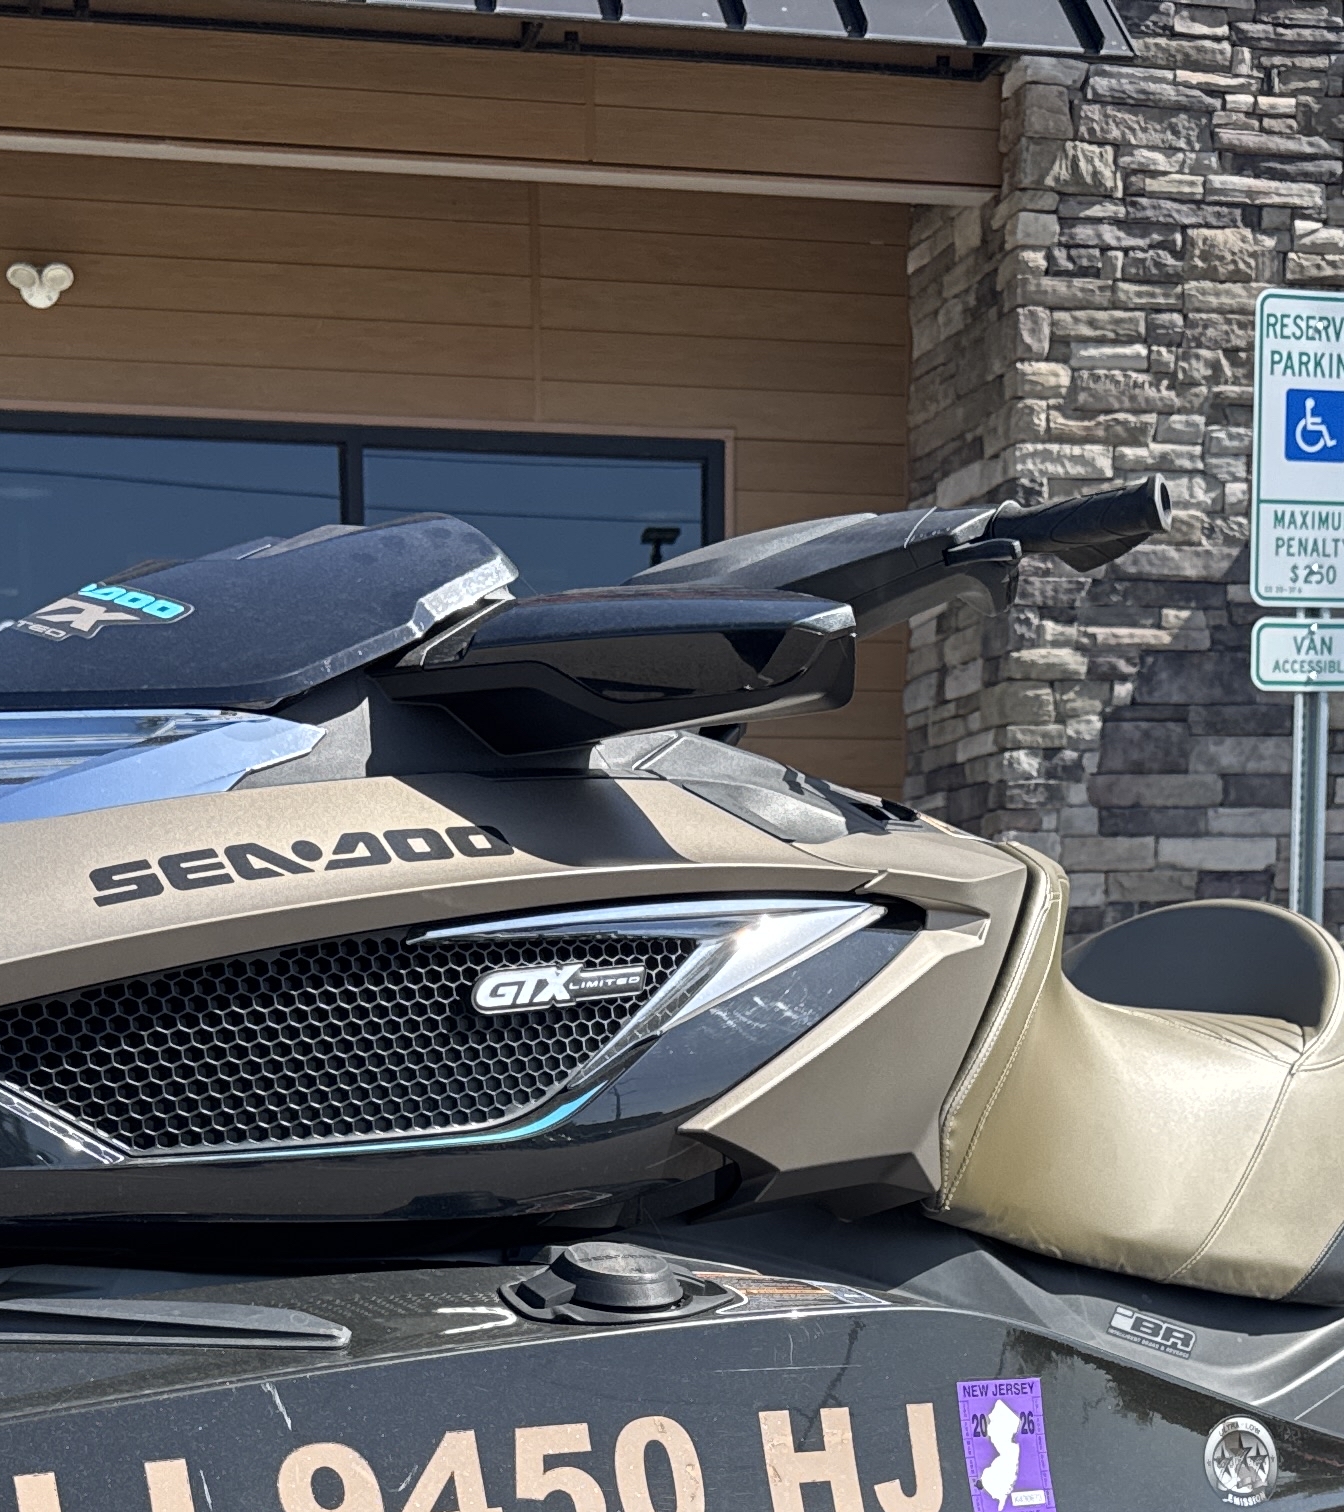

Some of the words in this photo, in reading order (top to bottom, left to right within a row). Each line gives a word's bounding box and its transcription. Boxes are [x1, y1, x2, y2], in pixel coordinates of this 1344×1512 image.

[1289, 564, 1337, 585] $250
[1293, 635, 1334, 656] VAN
[476, 963, 584, 1008] GTX
[569, 976, 641, 990] LIMITED
[962, 1384, 988, 1398] NEW
[992, 1382, 1035, 1397] JERSEY
[972, 1413, 988, 1437] 20
[1020, 1411, 1035, 1435] 26
